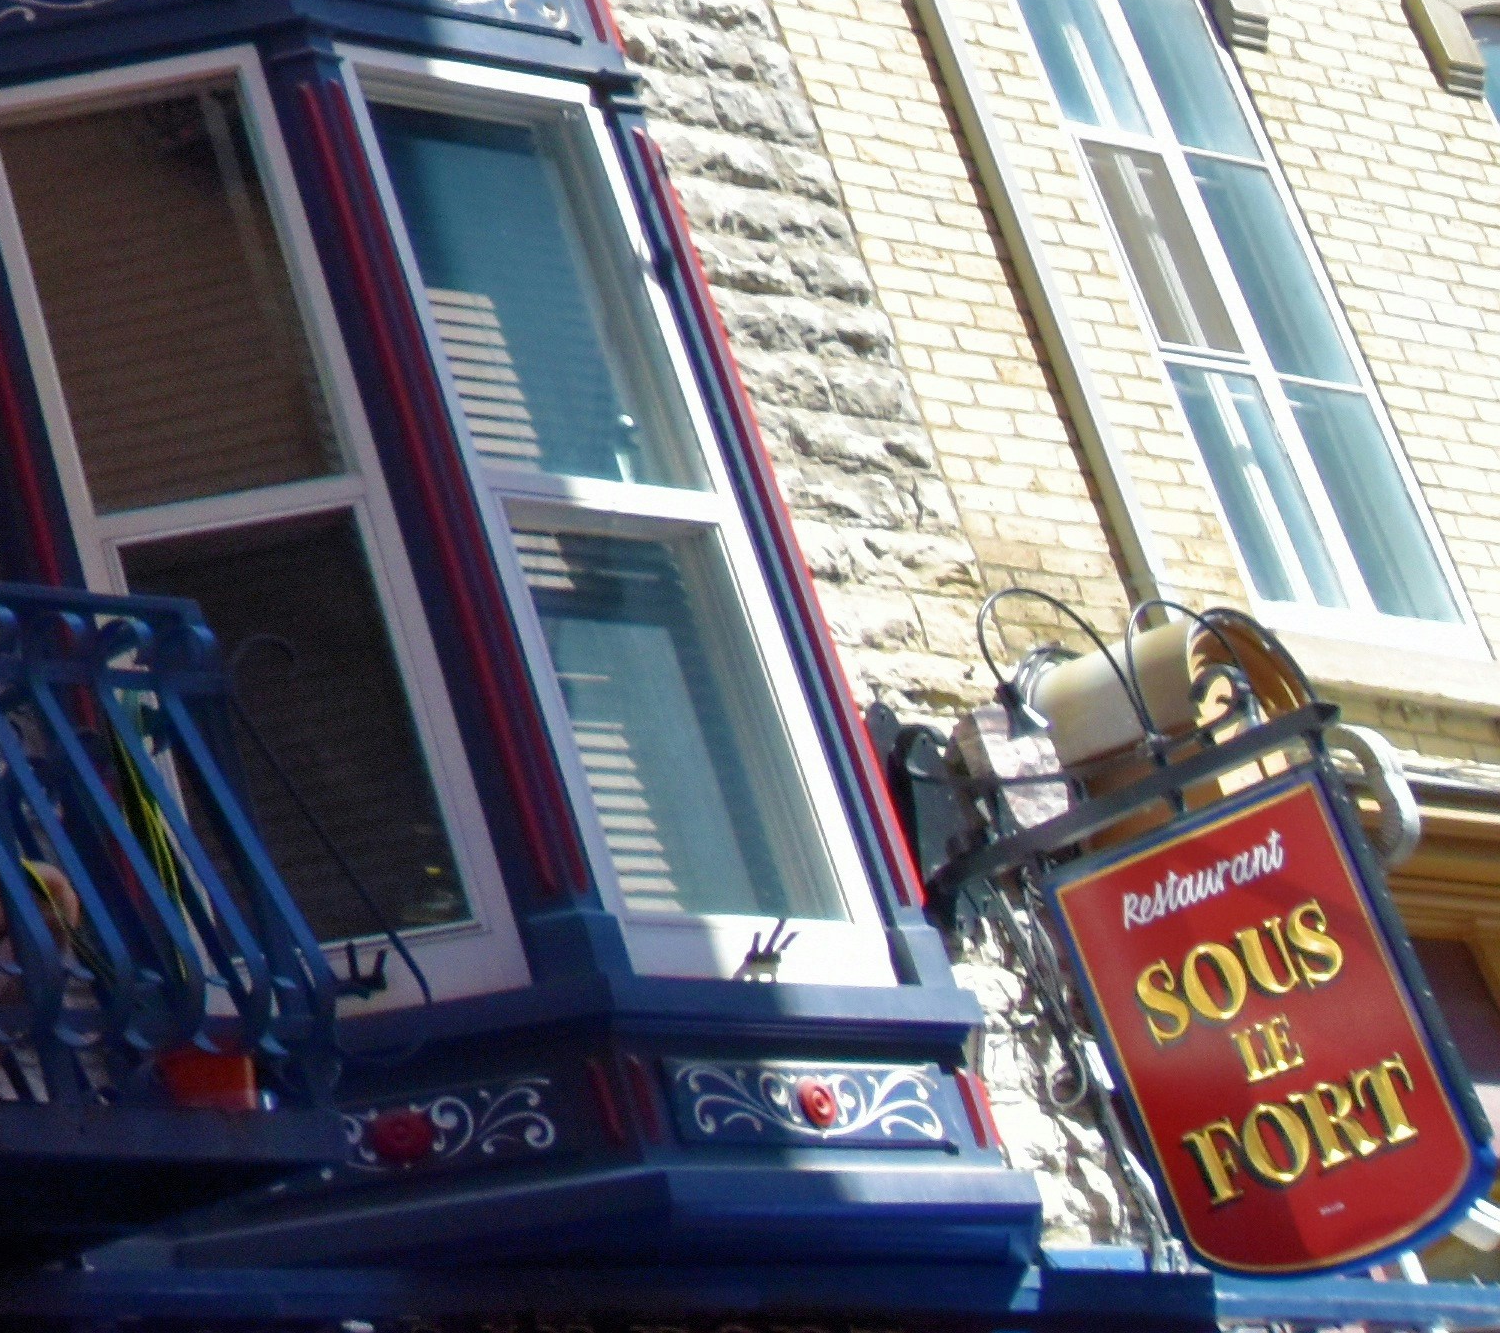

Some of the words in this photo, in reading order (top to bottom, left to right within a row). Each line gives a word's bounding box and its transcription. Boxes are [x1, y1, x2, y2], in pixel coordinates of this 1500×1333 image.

[1122, 828, 1285, 930] Restaurant
[1135, 897, 1345, 1047] SOUS
[1230, 1013, 1305, 1083] LE
[1182, 1052, 1420, 1208] FORT
